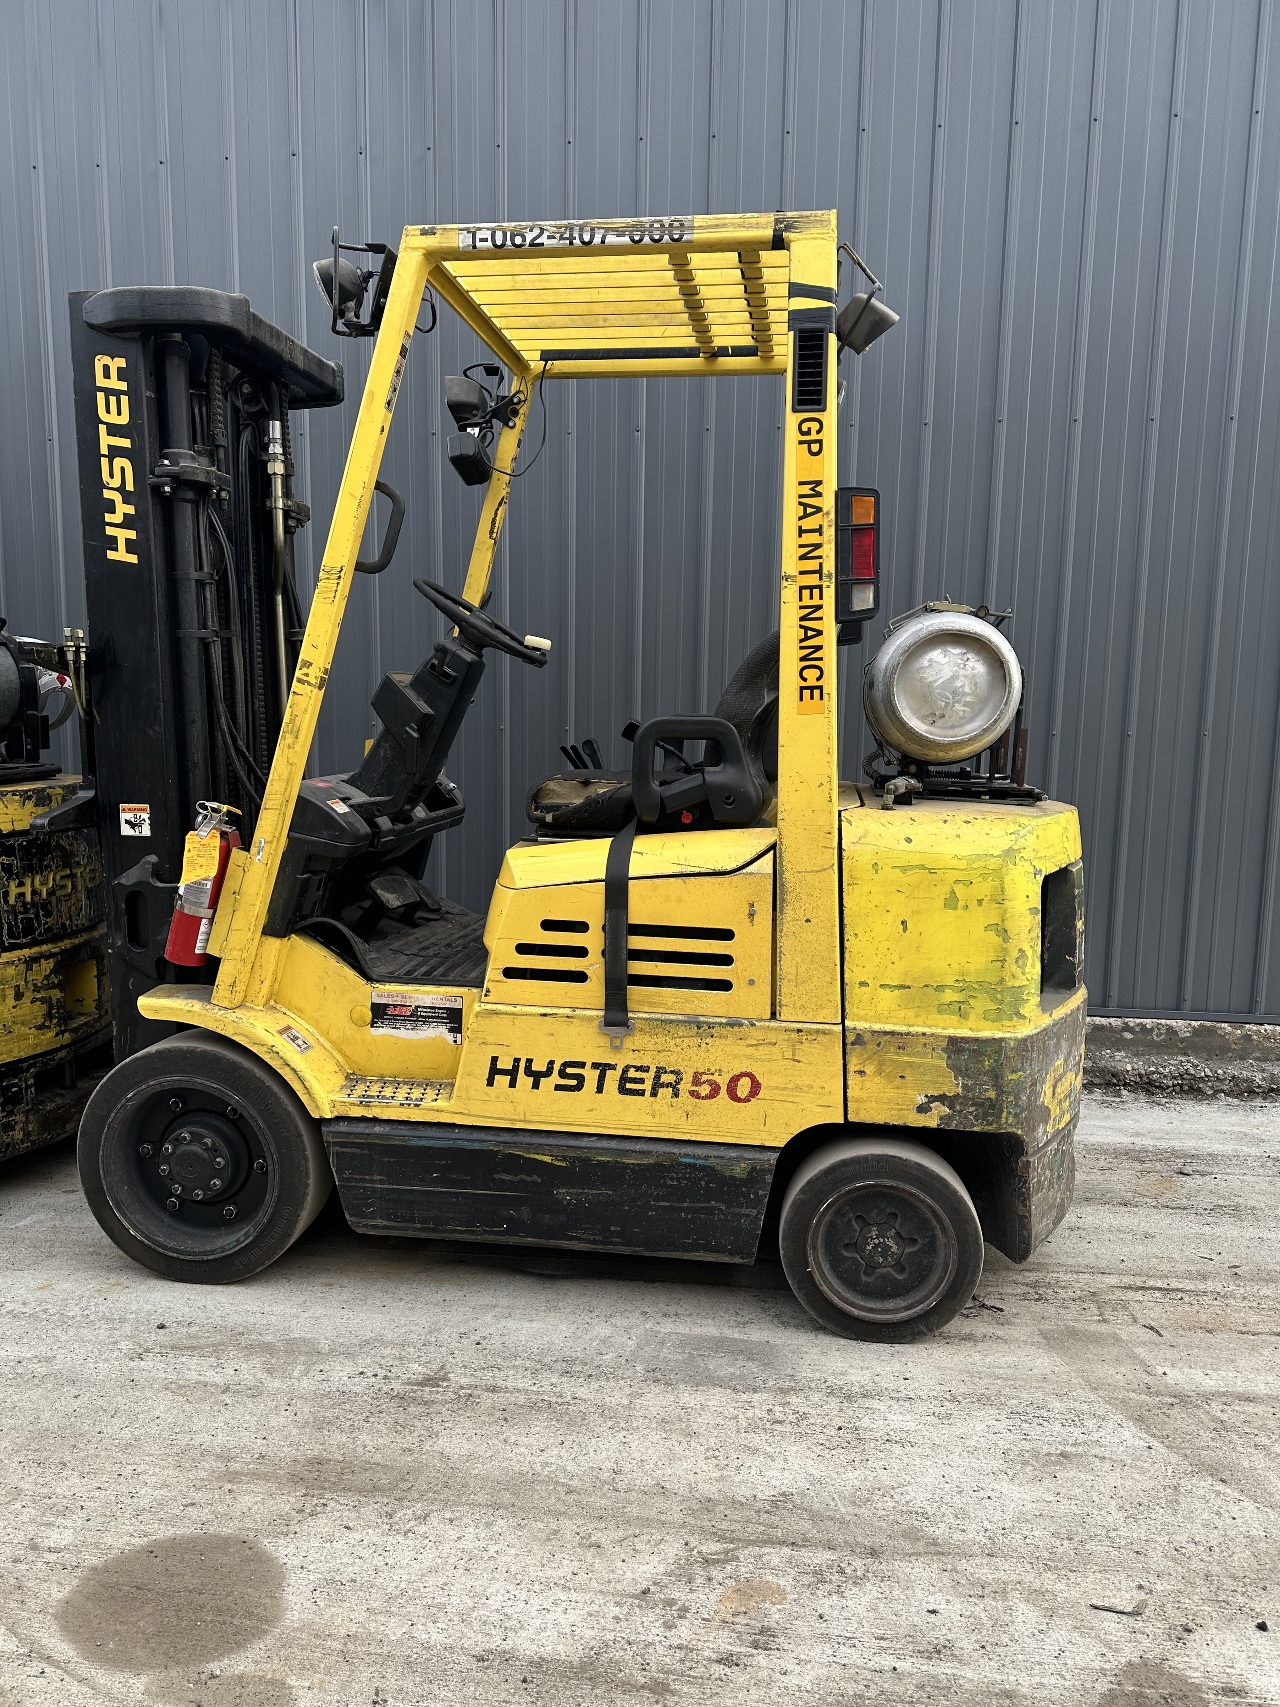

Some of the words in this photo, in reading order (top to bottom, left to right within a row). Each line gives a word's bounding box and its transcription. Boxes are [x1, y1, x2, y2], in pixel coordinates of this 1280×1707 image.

[94, 354, 139, 564] HYSTER
[798, 416, 824, 457] GP
[798, 480, 825, 702] MAINTENANCE
[486, 1055, 684, 1100] HYSTER
[688, 1070, 762, 1104] 50
